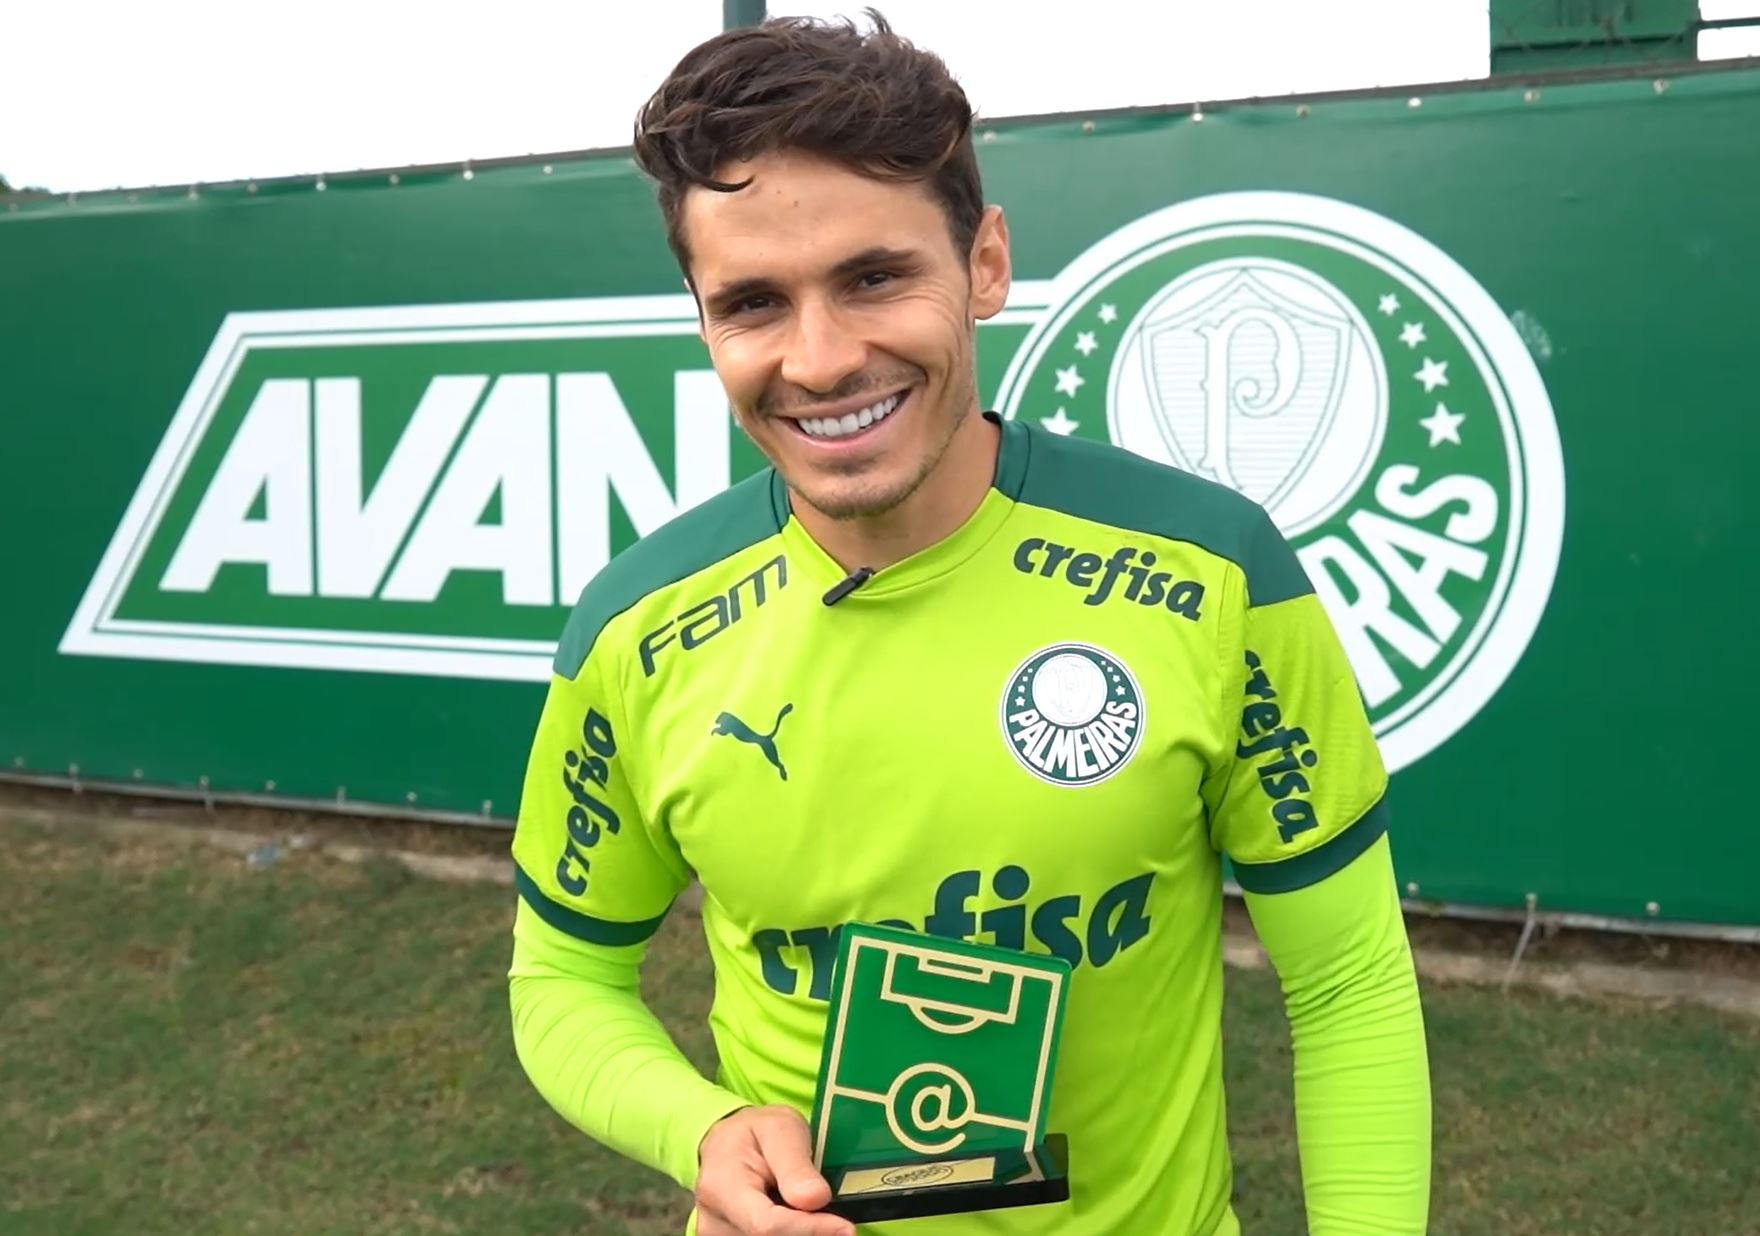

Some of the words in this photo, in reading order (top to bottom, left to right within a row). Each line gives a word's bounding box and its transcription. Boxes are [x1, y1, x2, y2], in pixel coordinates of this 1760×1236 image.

[1013, 538, 1205, 621] crefisa
[1009, 701, 1138, 778] PALMEIRAS
[556, 707, 620, 896] crefisa
[752, 865, 1156, 1003] crfisa
